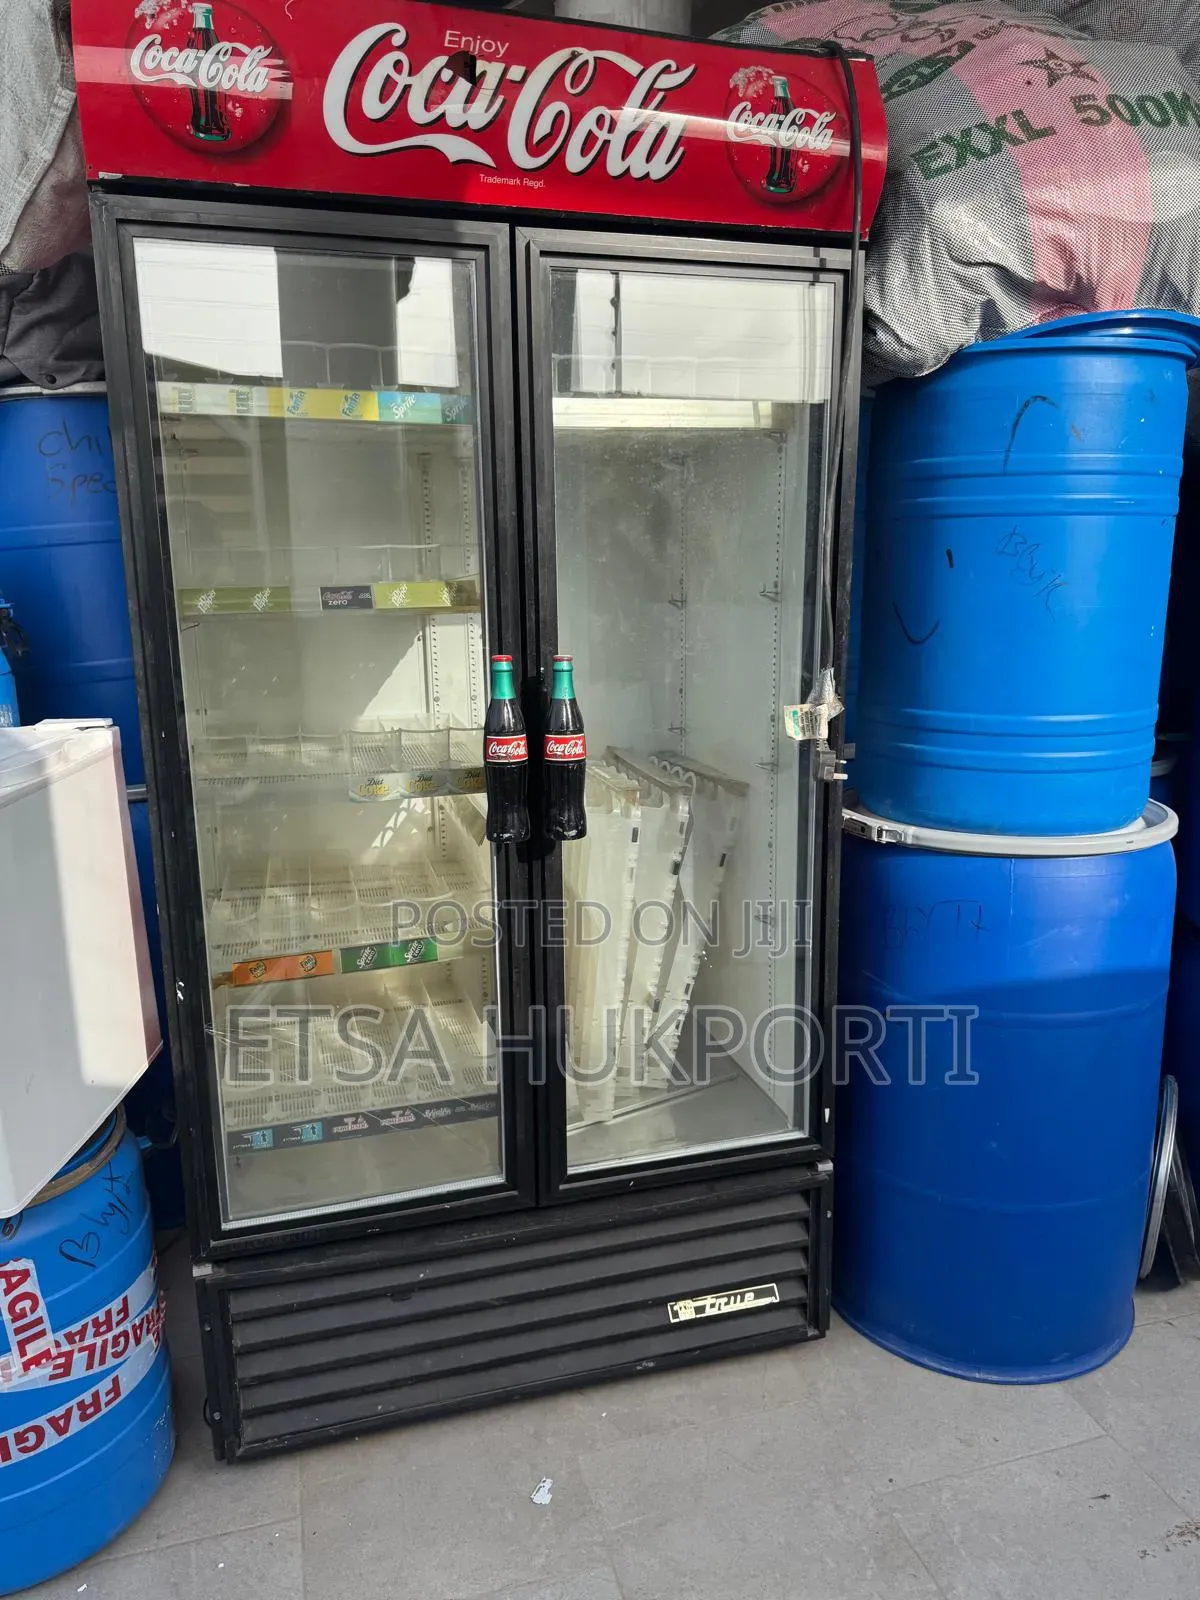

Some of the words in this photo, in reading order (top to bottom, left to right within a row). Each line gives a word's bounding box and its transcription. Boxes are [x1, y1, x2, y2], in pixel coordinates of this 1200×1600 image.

[444, 30, 509, 58] Enjoy
[130, 33, 273, 94] Coca-Cola
[322, 22, 697, 182] Coca-Cola
[725, 101, 838, 152] Coca-Cola
[911, 108, 1057, 181] EXXL
[479, 173, 521, 187] Trademark
[523, 178, 546, 189] Regd.
[391, 394, 417, 420] Sprite
[488, 740, 527, 757] Coca-Cola
[546, 740, 585, 756] Coca-Cola
